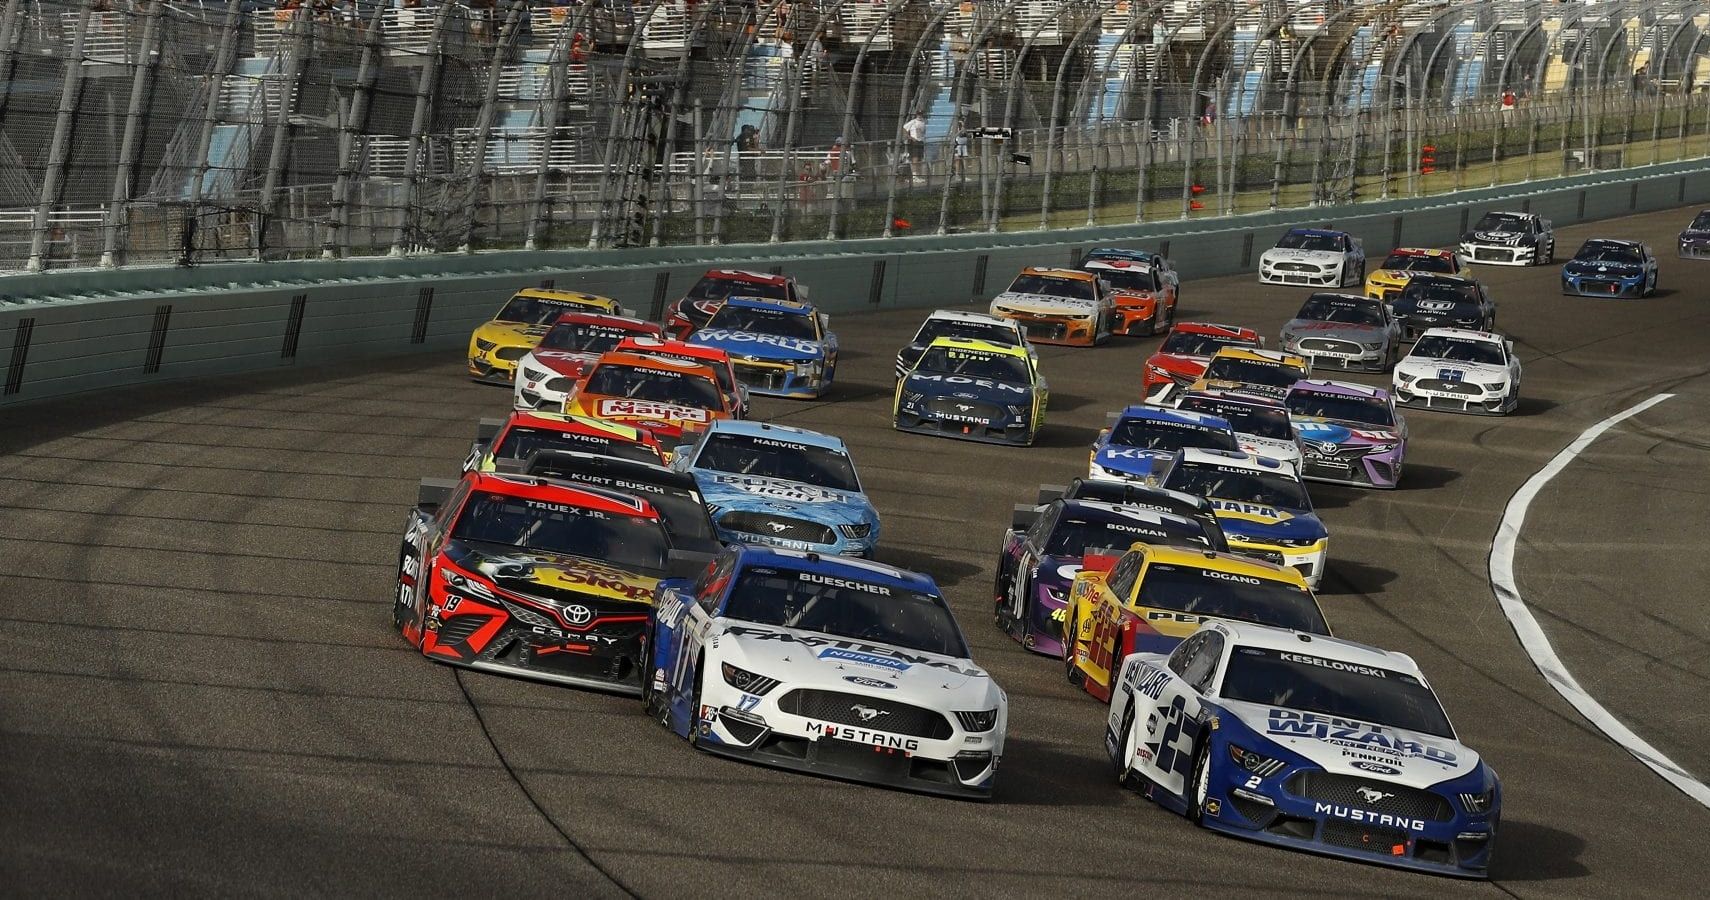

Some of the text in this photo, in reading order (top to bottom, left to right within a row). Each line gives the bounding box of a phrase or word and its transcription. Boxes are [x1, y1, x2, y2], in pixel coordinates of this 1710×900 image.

[589, 324, 627, 334] BLANEY
[951, 320, 993, 330] ALMIROLA
[697, 329, 818, 354] WORLD
[1196, 333, 1231, 341] WALLACE
[660, 352, 696, 362] DILLON
[1239, 358, 1281, 369] CHASTAIN
[633, 366, 682, 379] NEWMAN
[911, 374, 1026, 394] MOEN
[1313, 391, 1366, 402] KYLE BUSCH
[609, 405, 702, 420] Mayer
[906, 401, 915, 410] 21
[1216, 403, 1252, 413] HAMLIN
[935, 411, 991, 425] MUSTANG
[1145, 419, 1197, 431] STENHOUSE
[562, 432, 610, 445] BYRON
[752, 437, 808, 452] HARVICK
[1217, 465, 1262, 477] ELLIOTT
[571, 472, 666, 495] KURT BUSCH
[714, 475, 848, 504] BUSCH
[744, 486, 815, 502] LIGHT
[525, 500, 612, 521] TRUEX JR.
[1122, 500, 1174, 514] LARSON
[1210, 500, 1279, 519] NAPA
[1106, 522, 1168, 539] BOWMAN
[736, 532, 815, 551] MUSTANG
[799, 572, 892, 597] BUESCHER
[1202, 569, 1261, 586] LOGANO
[442, 593, 462, 613] 19
[532, 625, 618, 645] CAMRY
[722, 626, 989, 678] FASTENAL
[829, 650, 901, 667] NORTON
[1279, 652, 1387, 679] KESELOWSKI
[853, 676, 887, 688] Ford
[1268, 708, 1393, 735] DENT
[805, 721, 920, 751] MUSTANG
[1267, 718, 1457, 762] WIZARD
[1341, 750, 1405, 768] PENNZOIL
[1358, 761, 1393, 774] Ford
[1244, 775, 1263, 789] 2
[1315, 802, 1426, 832] MUSTANG
